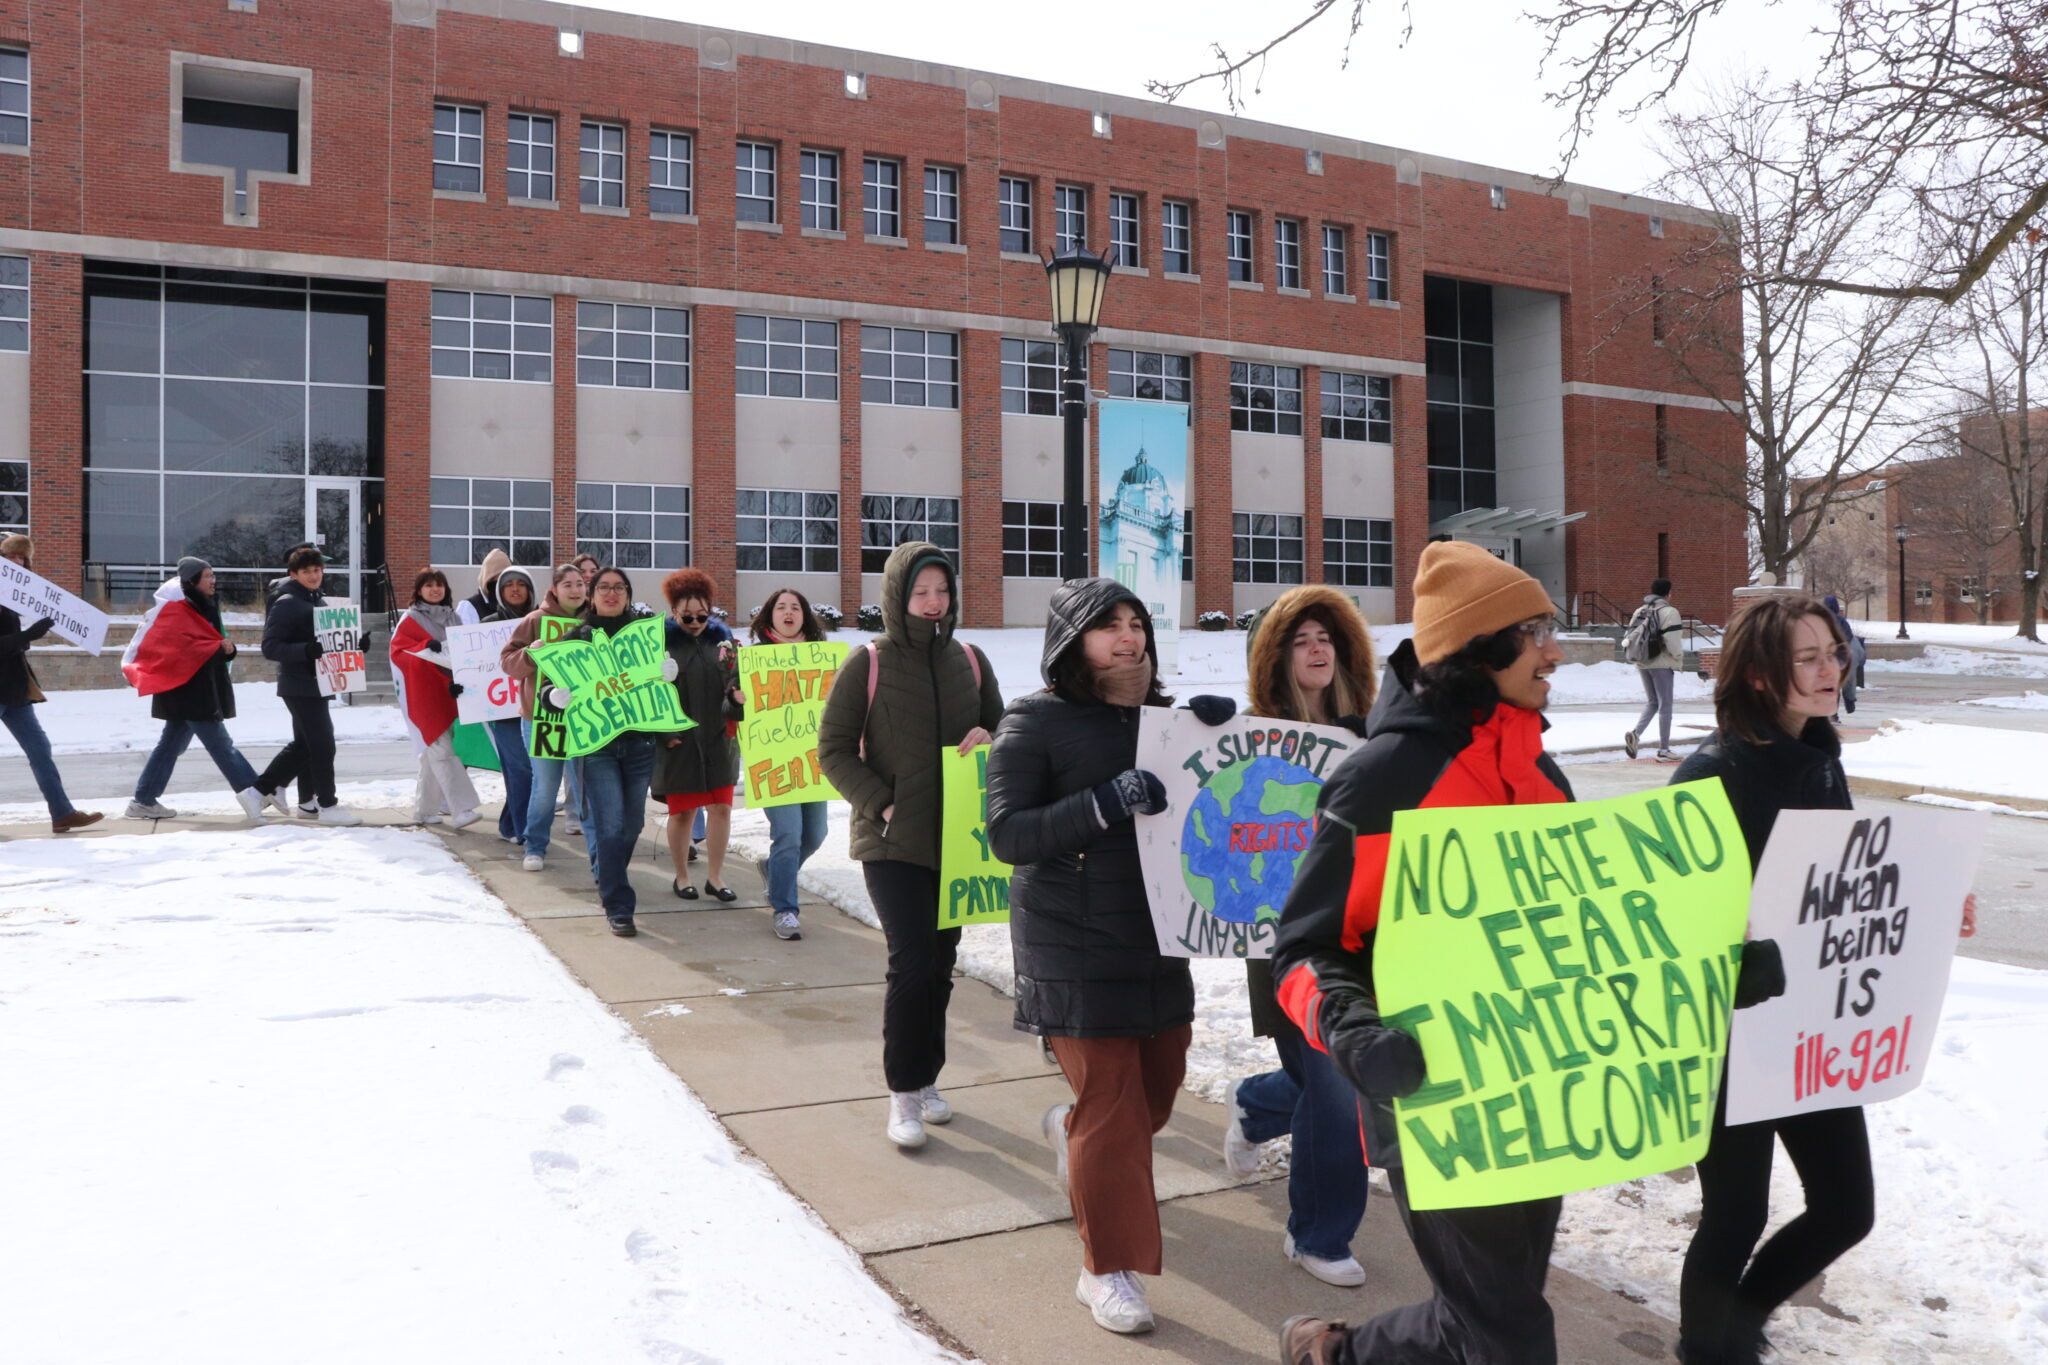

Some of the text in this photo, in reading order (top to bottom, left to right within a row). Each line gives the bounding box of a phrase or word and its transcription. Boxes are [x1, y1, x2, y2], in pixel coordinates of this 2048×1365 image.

[1, 564, 63, 606] STOP THE
[12, 588, 89, 639] DEPORTATIONS
[741, 642, 837, 674] Blinded By
[595, 672, 635, 700] ARE
[567, 680, 688, 751] ESSENTIAL
[748, 705, 819, 751] Fueled
[1183, 728, 1348, 789] I SUPPORT
[1229, 821, 1309, 853] RIGHTS
[1394, 790, 1725, 922] NO HATE NO
[1176, 901, 1281, 958] GRANT
[1478, 889, 1682, 992] FEAR
[1818, 905, 1910, 969] being
[1834, 967, 1882, 1020] is
[1794, 1015, 1912, 1103] illegal.
